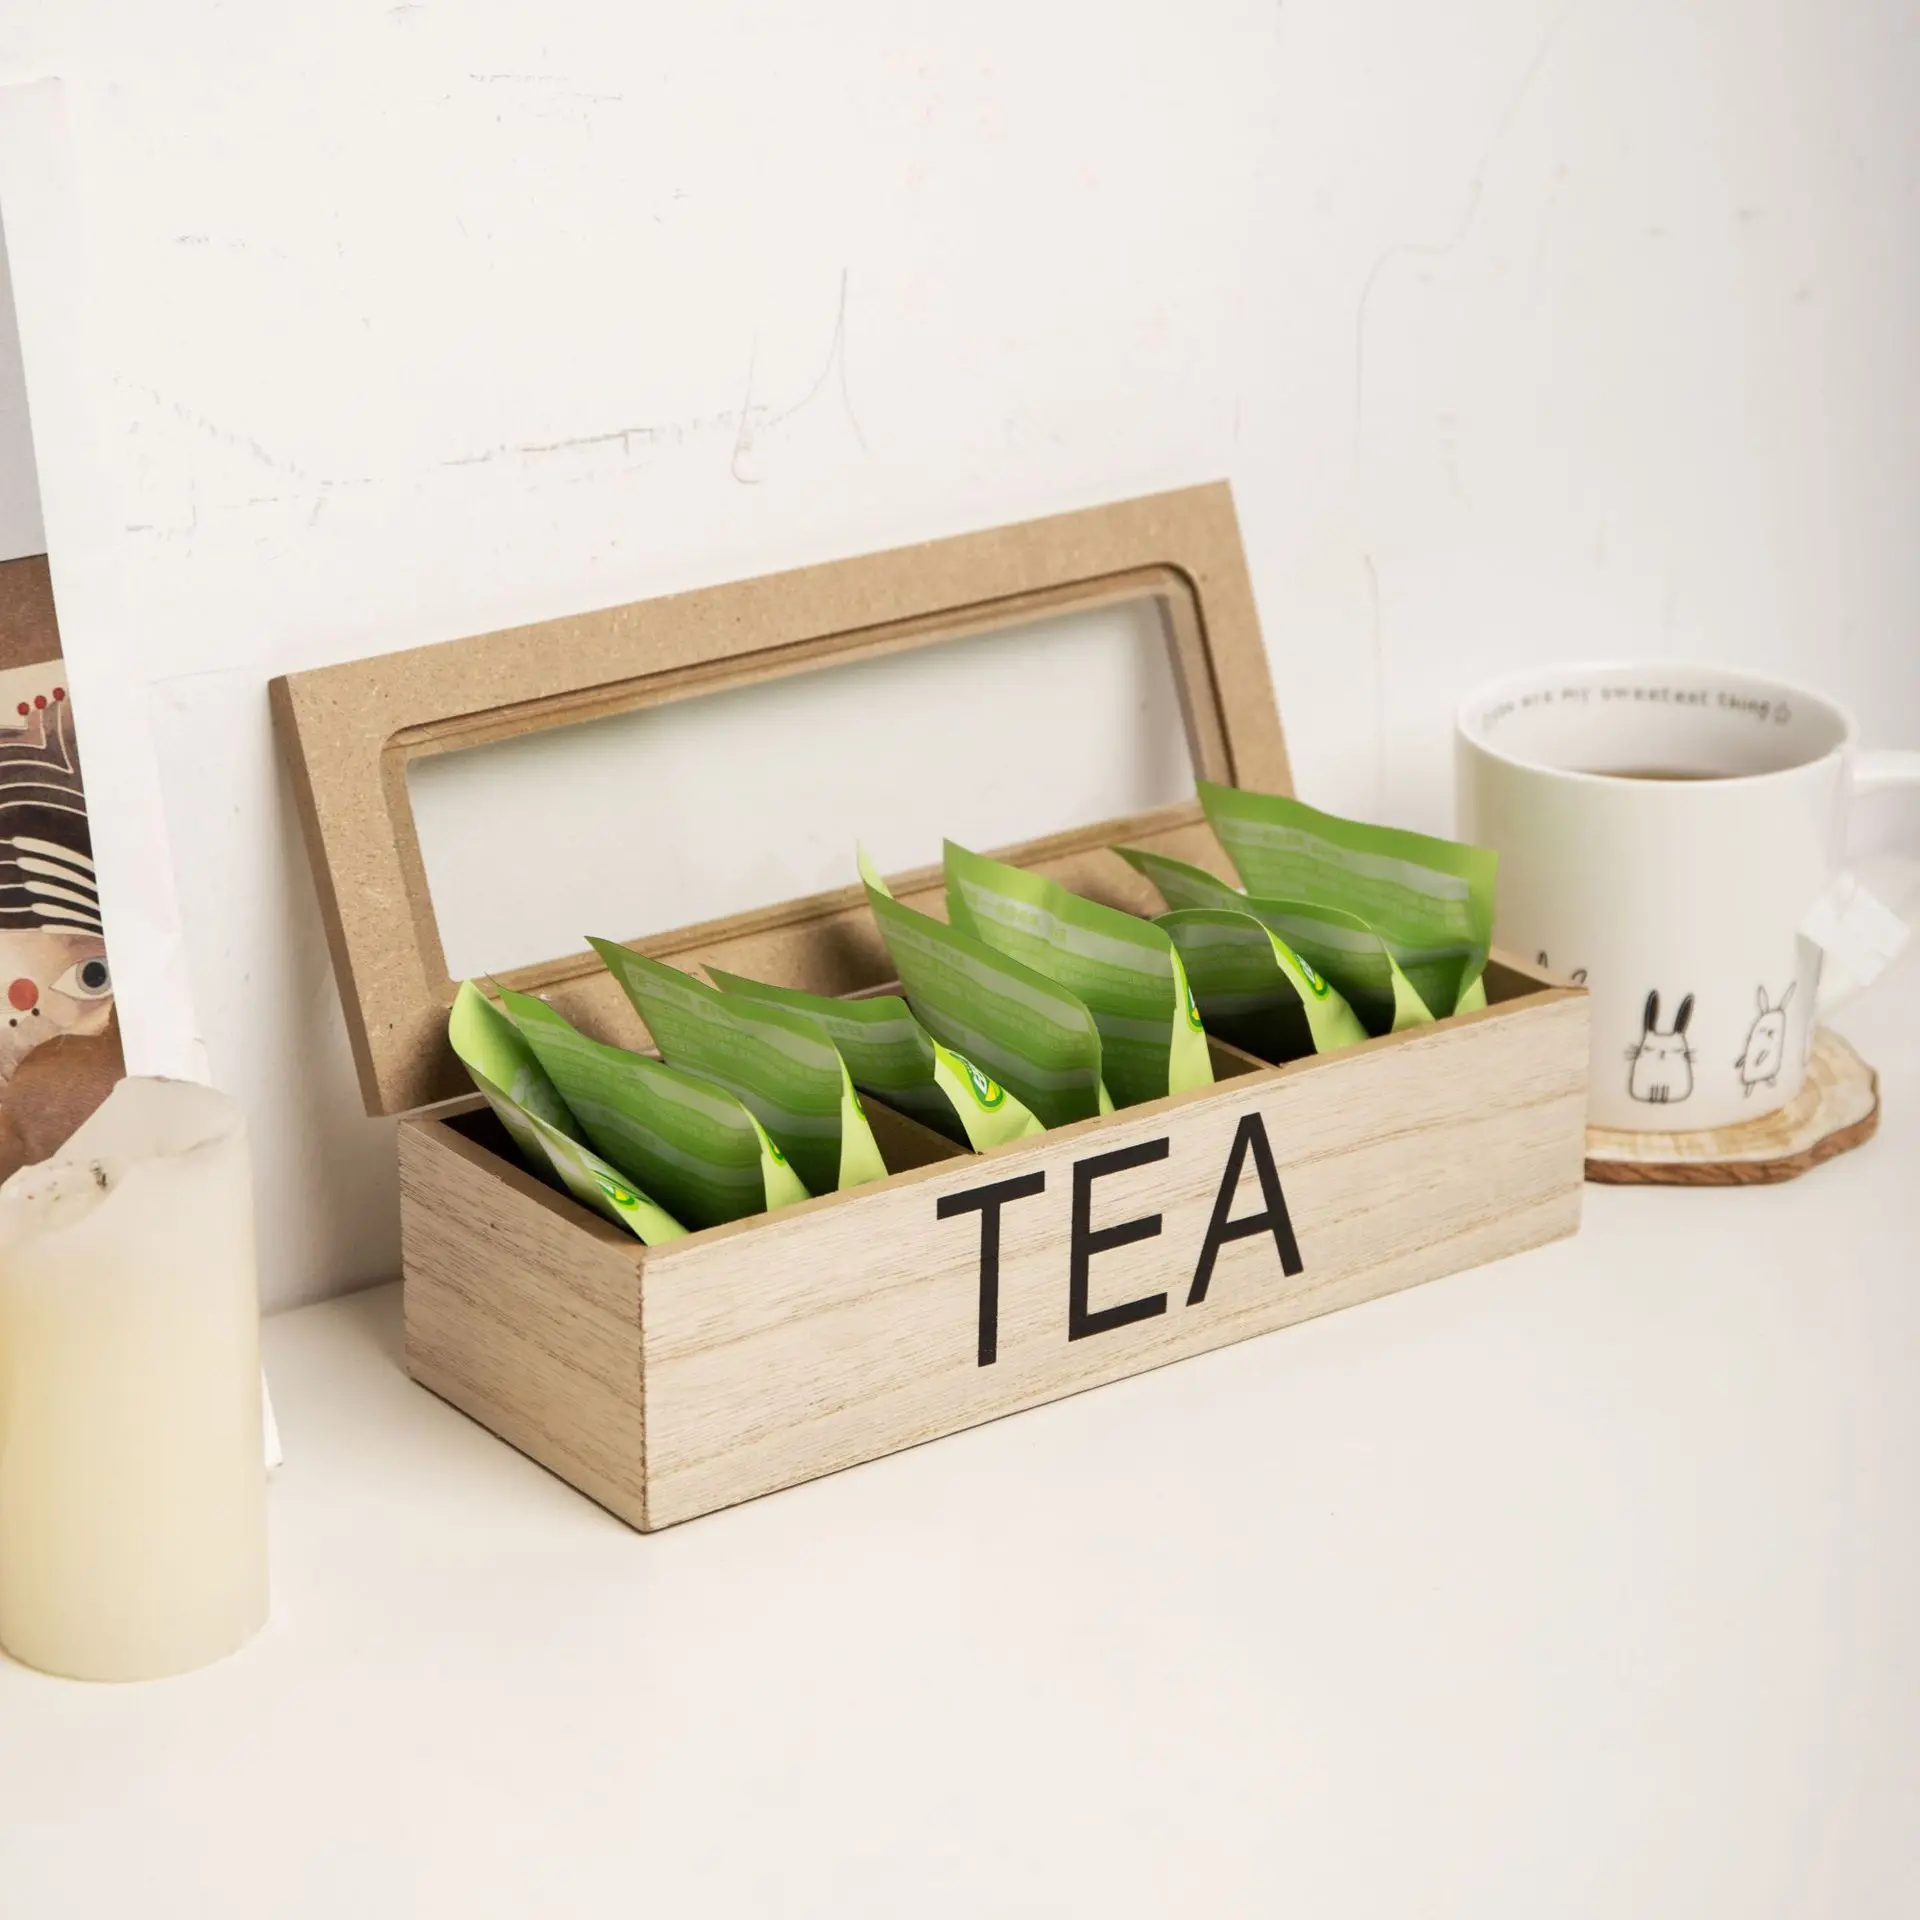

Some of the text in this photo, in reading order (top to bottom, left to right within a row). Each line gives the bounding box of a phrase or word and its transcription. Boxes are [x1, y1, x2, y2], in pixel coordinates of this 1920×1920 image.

[1600, 687, 1707, 705] sweetest
[1717, 691, 1771, 722] thing
[936, 1112, 1304, 1367] TEA
